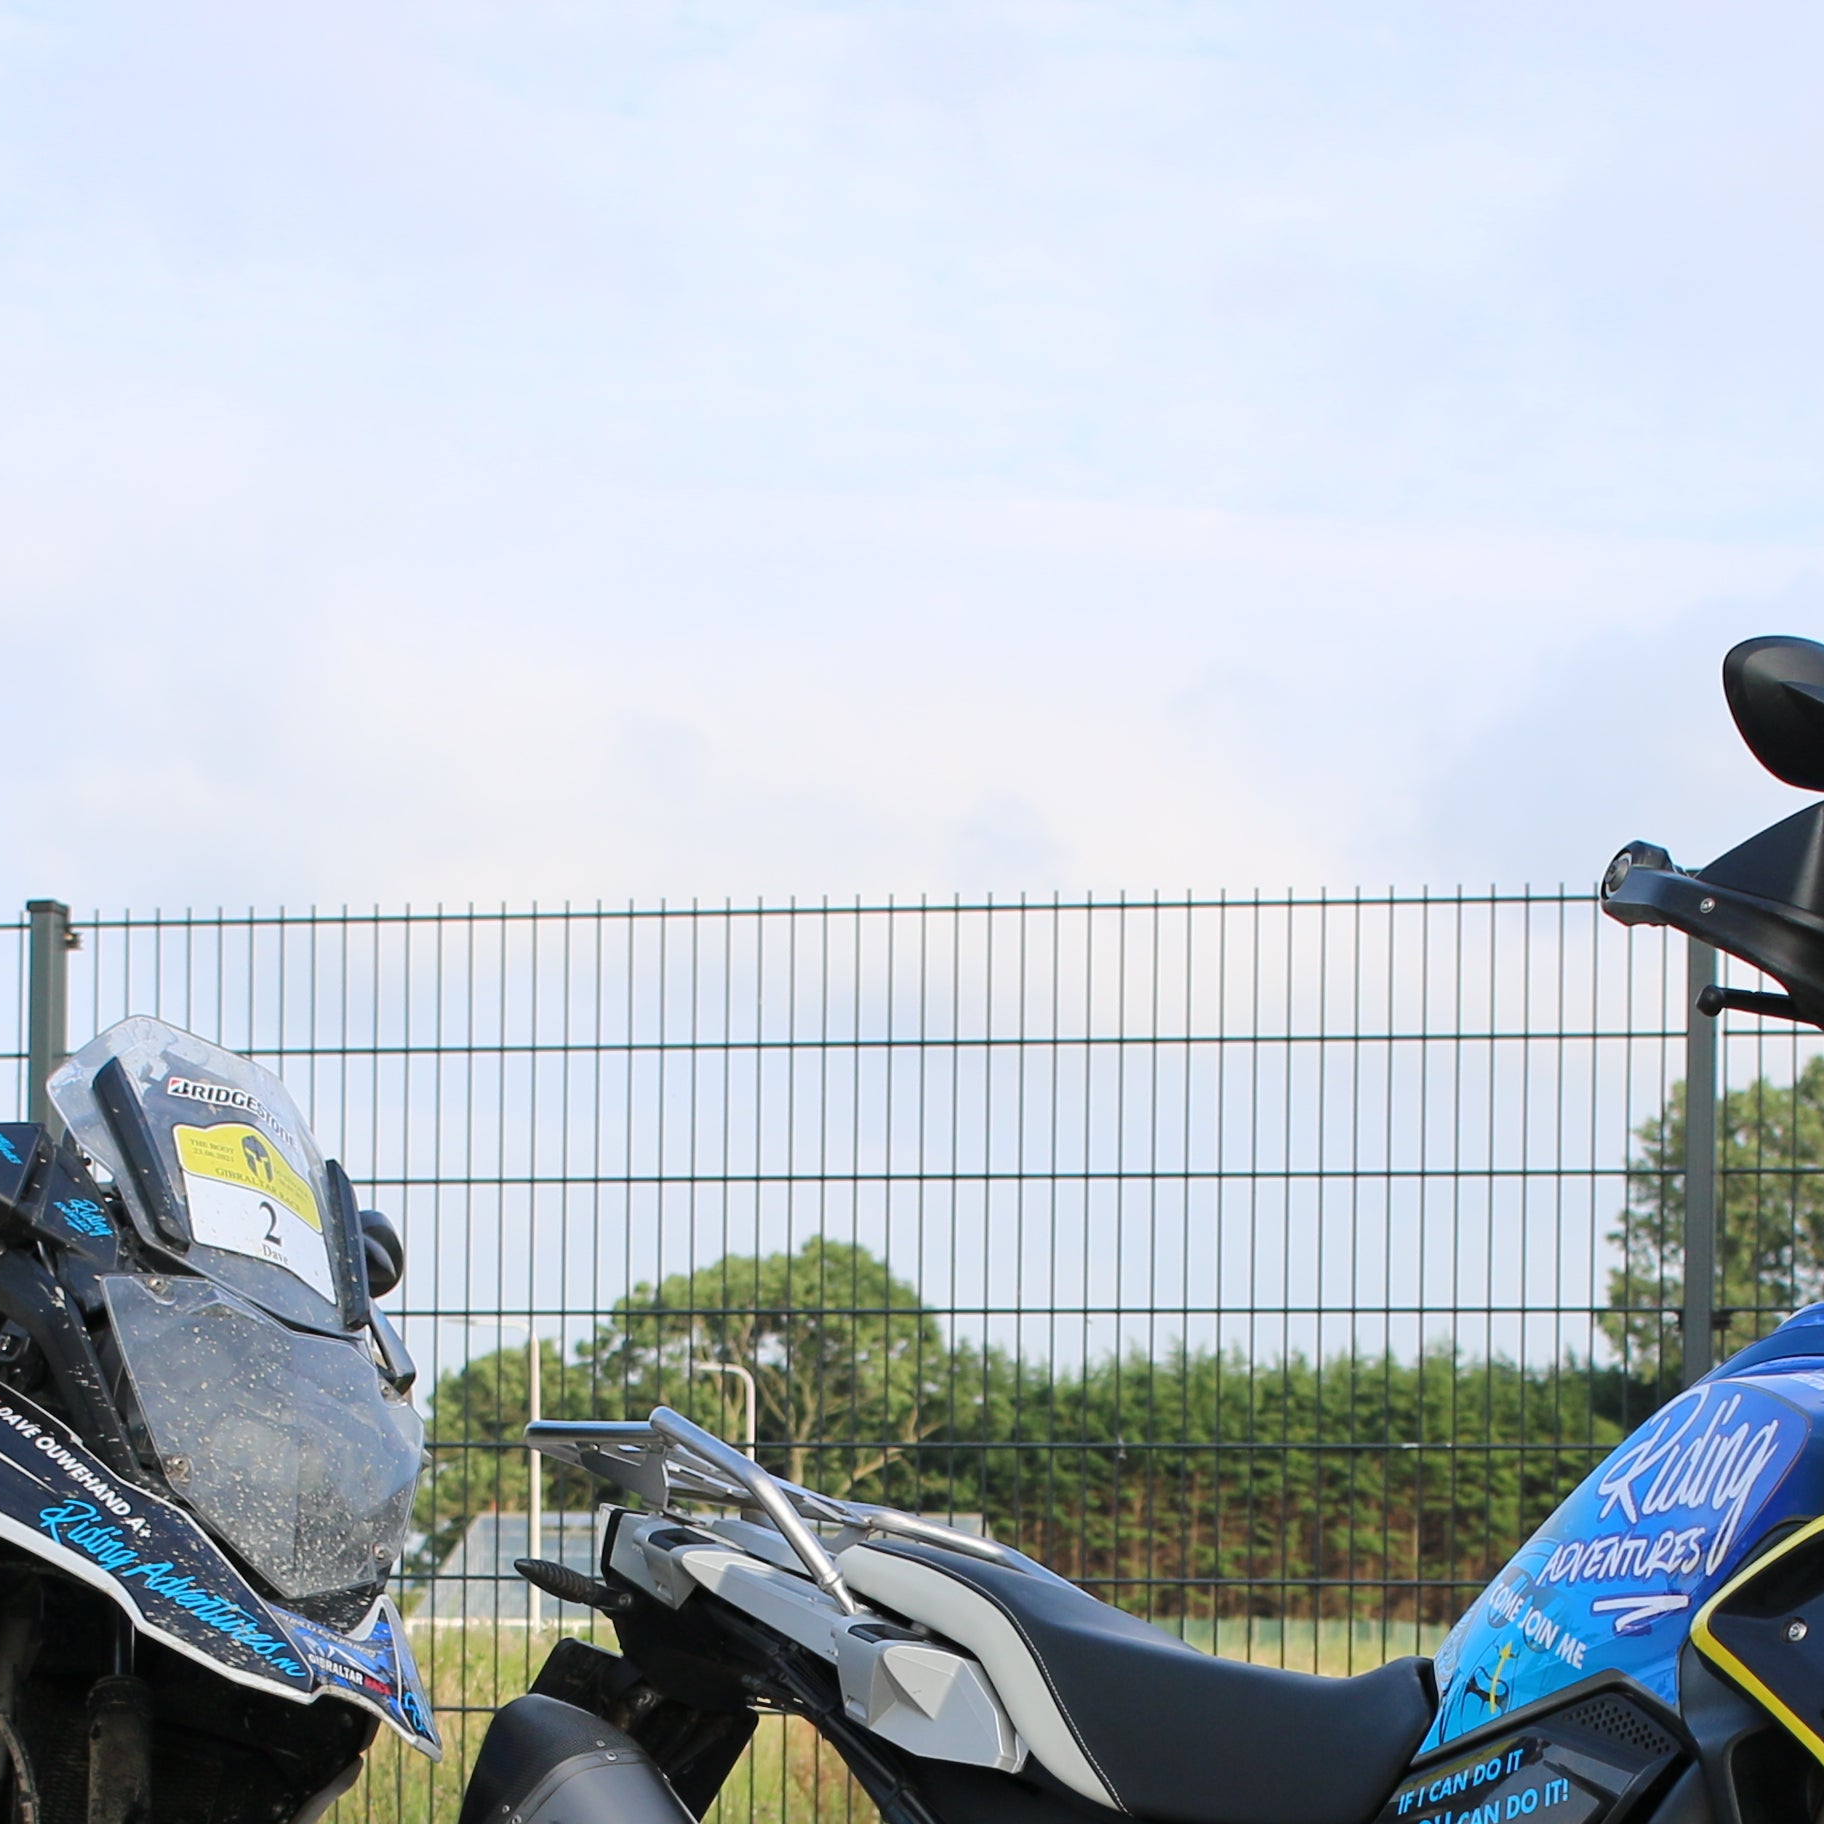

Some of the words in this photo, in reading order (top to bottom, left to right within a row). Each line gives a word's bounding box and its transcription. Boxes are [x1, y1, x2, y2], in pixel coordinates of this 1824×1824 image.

[169, 1078, 294, 1146] BRIDGESTONE
[259, 1201, 283, 1247] 2
[262, 1243, 290, 1267] Dave
[34, 1434, 133, 1518] OUWEHAND
[126, 1515, 154, 1540] A+
[1597, 1382, 1780, 1577] Riding
[39, 1498, 139, 1574] Riding
[1535, 1526, 1707, 1587] ADVENTURES
[307, 1652, 364, 1686] GIBRALTAR
[1517, 1606, 1561, 1651] JOIN
[1554, 1632, 1588, 1671] ME
[1396, 1792, 1415, 1816] IF
[1417, 1786, 1426, 1808] I
[1428, 1768, 1470, 1803] CAN
[1472, 1757, 1502, 1788] DO
[1506, 1748, 1525, 1775] IT
[1505, 1787, 1539, 1821] DO
[1544, 1777, 1570, 1808] IT!
